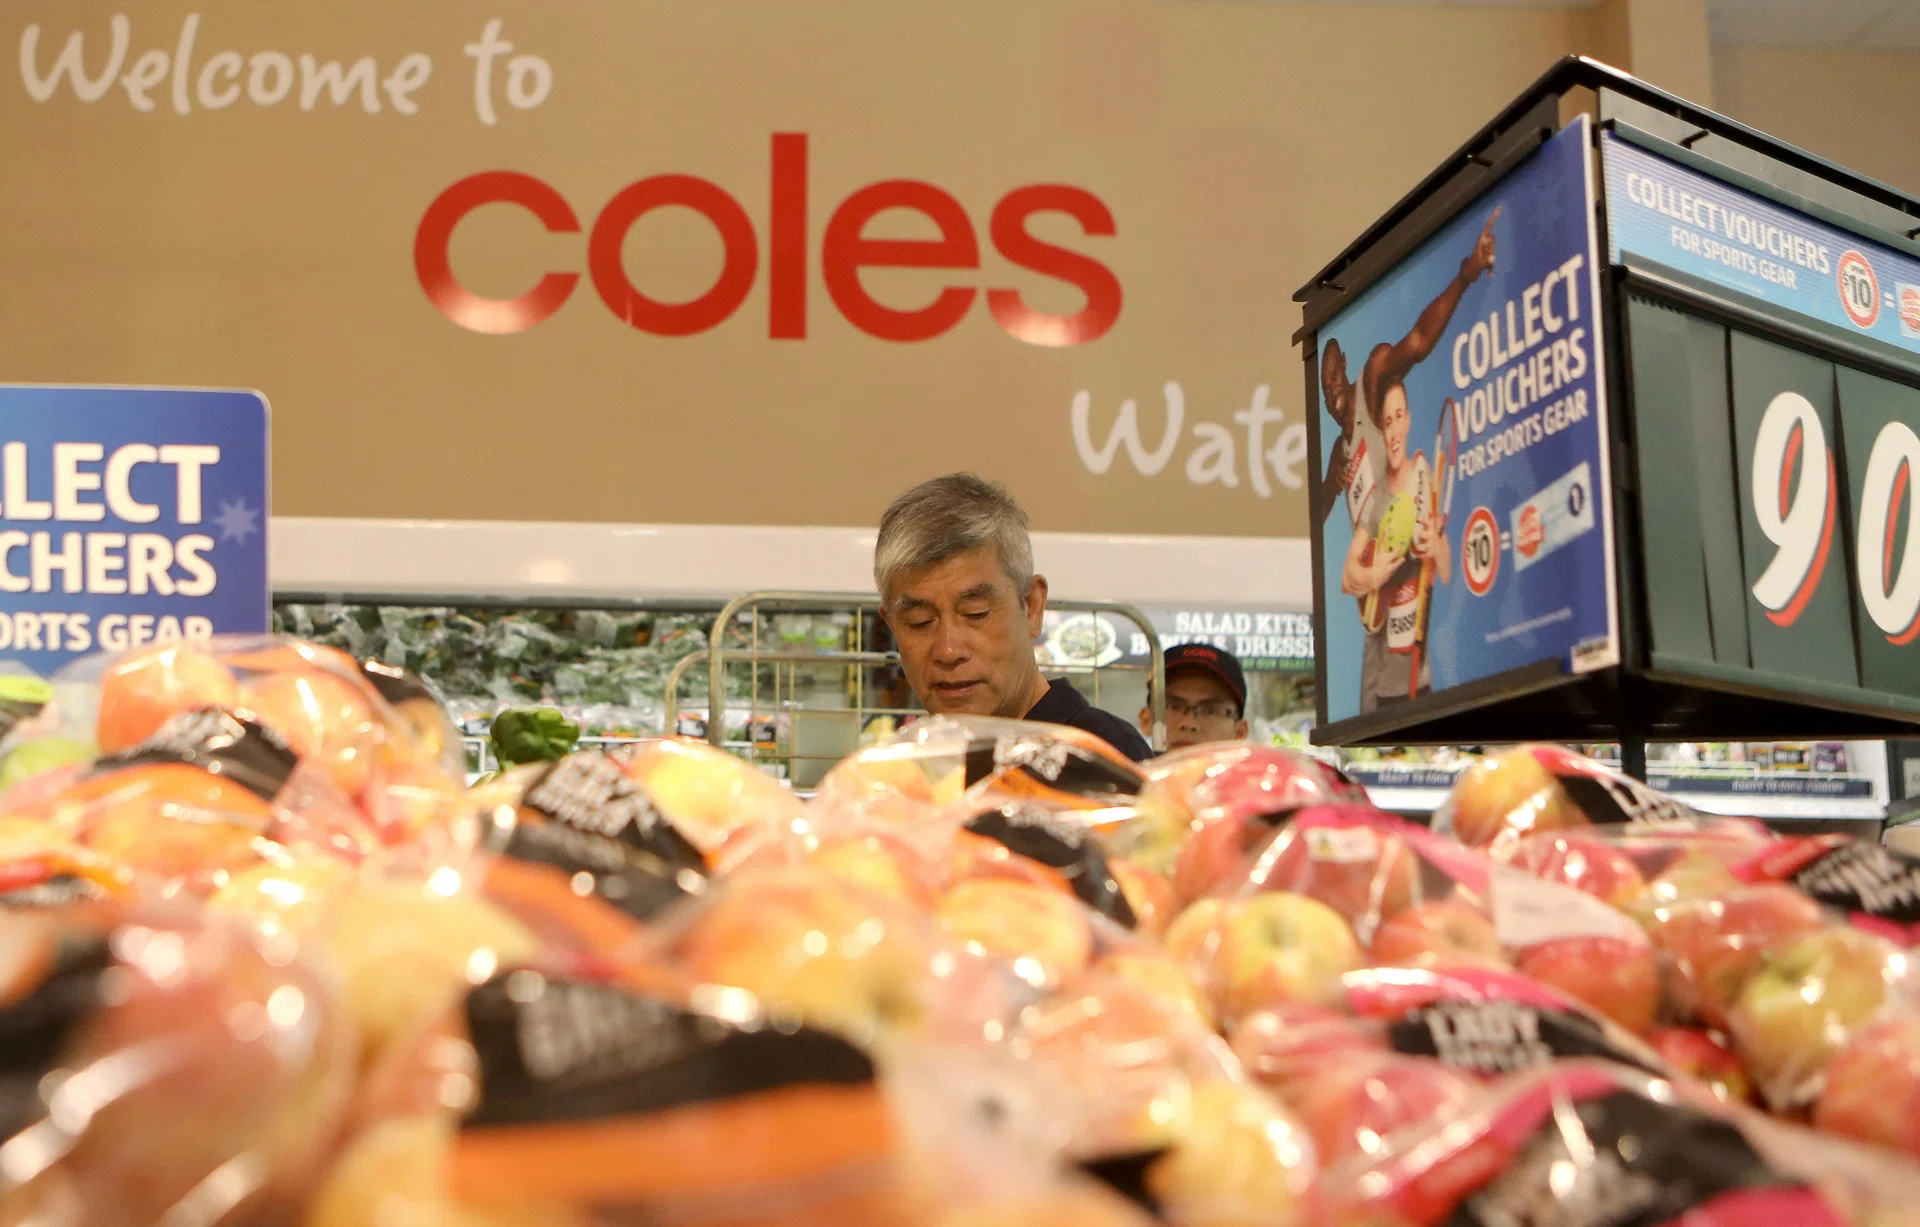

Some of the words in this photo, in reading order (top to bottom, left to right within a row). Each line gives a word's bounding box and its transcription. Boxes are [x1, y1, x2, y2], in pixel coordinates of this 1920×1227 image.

[20, 13, 432, 116] Welcome
[464, 18, 553, 126] to
[413, 132, 1123, 346] coles
[1627, 172, 1718, 233] COLLECT
[1721, 207, 1831, 275] VOUCHERS
[1671, 225, 1701, 257] FOR
[1702, 237, 1757, 276] SPORTS
[1760, 259, 1798, 291] GEAR
[1453, 253, 1584, 389] COLLECT
[1455, 327, 1588, 443] VOUCHERS
[1458, 444, 1488, 481] FOR
[1486, 412, 1544, 467] SPORTS
[1543, 388, 1590, 436] GEAR
[0, 441, 221, 526] LECT
[1071, 380, 1307, 499] Wate
[97, 613, 214, 652] GEAR
[1175, 612, 1251, 634] SALAD
